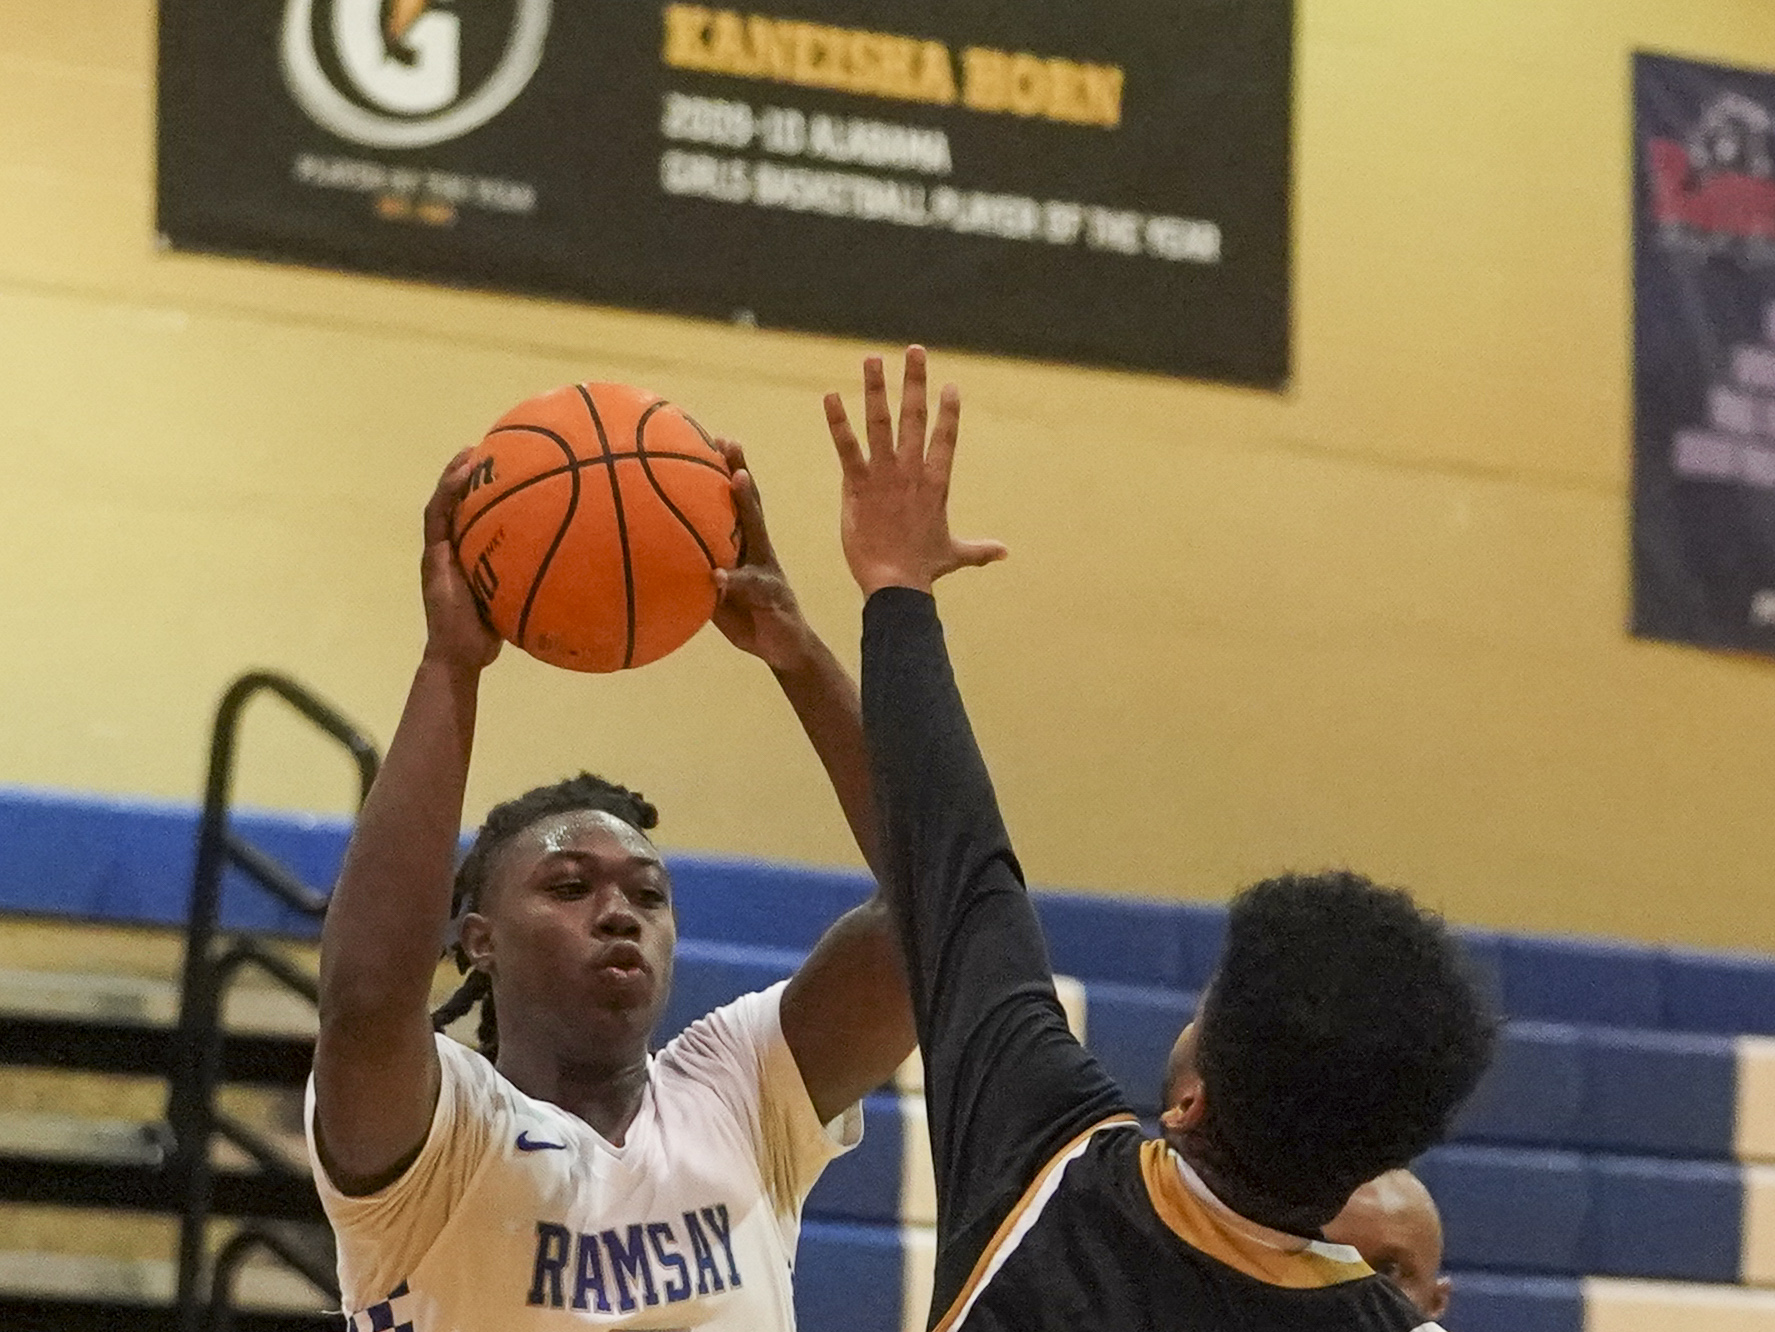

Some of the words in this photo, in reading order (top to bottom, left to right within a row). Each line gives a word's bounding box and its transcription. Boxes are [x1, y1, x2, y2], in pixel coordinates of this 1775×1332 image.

[752, 161, 927, 227] BASKETBALL
[928, 185, 1041, 240] PLAYER
[1044, 201, 1083, 244] OF
[1085, 205, 1141, 256] THE
[1145, 215, 1222, 264] YEAR
[526, 1203, 743, 1315] RAMSAY
